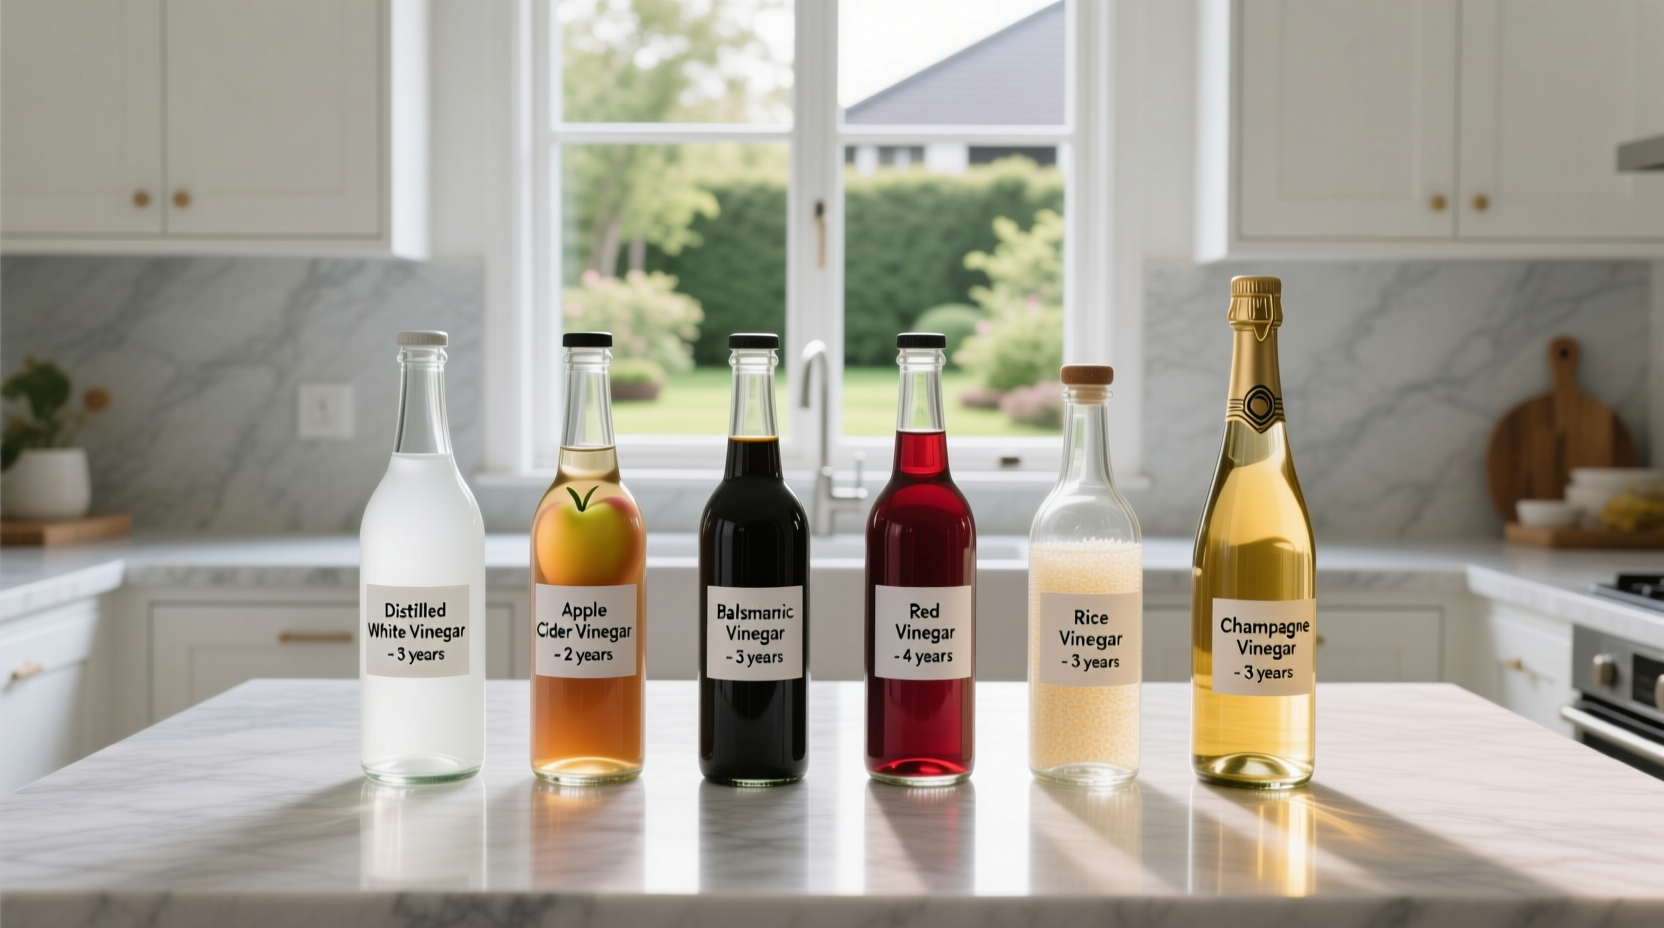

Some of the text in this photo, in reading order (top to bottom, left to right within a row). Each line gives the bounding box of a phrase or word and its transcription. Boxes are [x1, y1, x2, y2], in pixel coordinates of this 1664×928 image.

[384, 602, 446, 618] Distilled
[561, 601, 608, 621] Apple
[717, 603, 795, 620] Balsmanic
[909, 602, 940, 620] Red
[1074, 609, 1109, 625] Rice
[367, 623, 466, 642] White Vinegar
[536, 622, 633, 643] Cider Vinegar
[725, 624, 786, 646] Vinegar
[894, 623, 956, 644] Vinegar
[1220, 616, 1310, 639] Champagne
[1058, 630, 1124, 650] Vinegar
[397, 647, 406, 661] 3
[408, 648, 445, 665] years
[563, 647, 573, 661] 2
[575, 649, 614, 666] years
[736, 649, 745, 664] 3
[747, 653, 784, 668] years
[902, 648, 912, 663] 4
[914, 651, 953, 667] years
[1236, 639, 1297, 661] Vinegar
[1071, 654, 1081, 668] 3
[1083, 656, 1120, 672] years
[1244, 664, 1254, 680] 3
[1256, 668, 1294, 683] years
